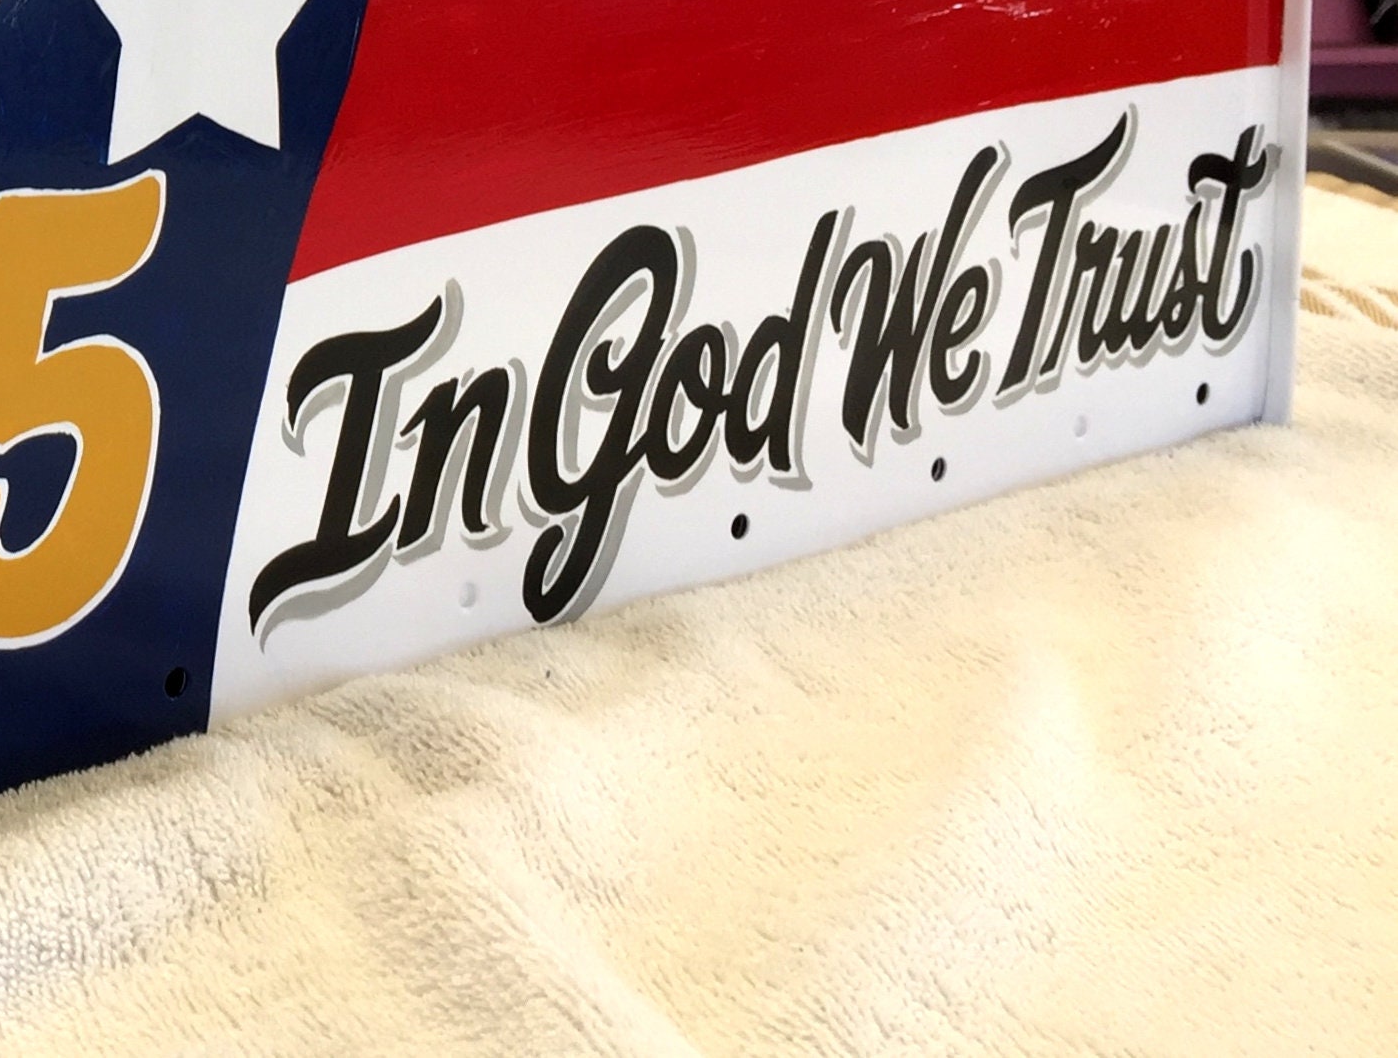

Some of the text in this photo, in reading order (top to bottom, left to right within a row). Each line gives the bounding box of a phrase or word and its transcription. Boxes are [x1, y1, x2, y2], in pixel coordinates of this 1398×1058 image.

[248, 110, 1272, 637] In God We Trust
